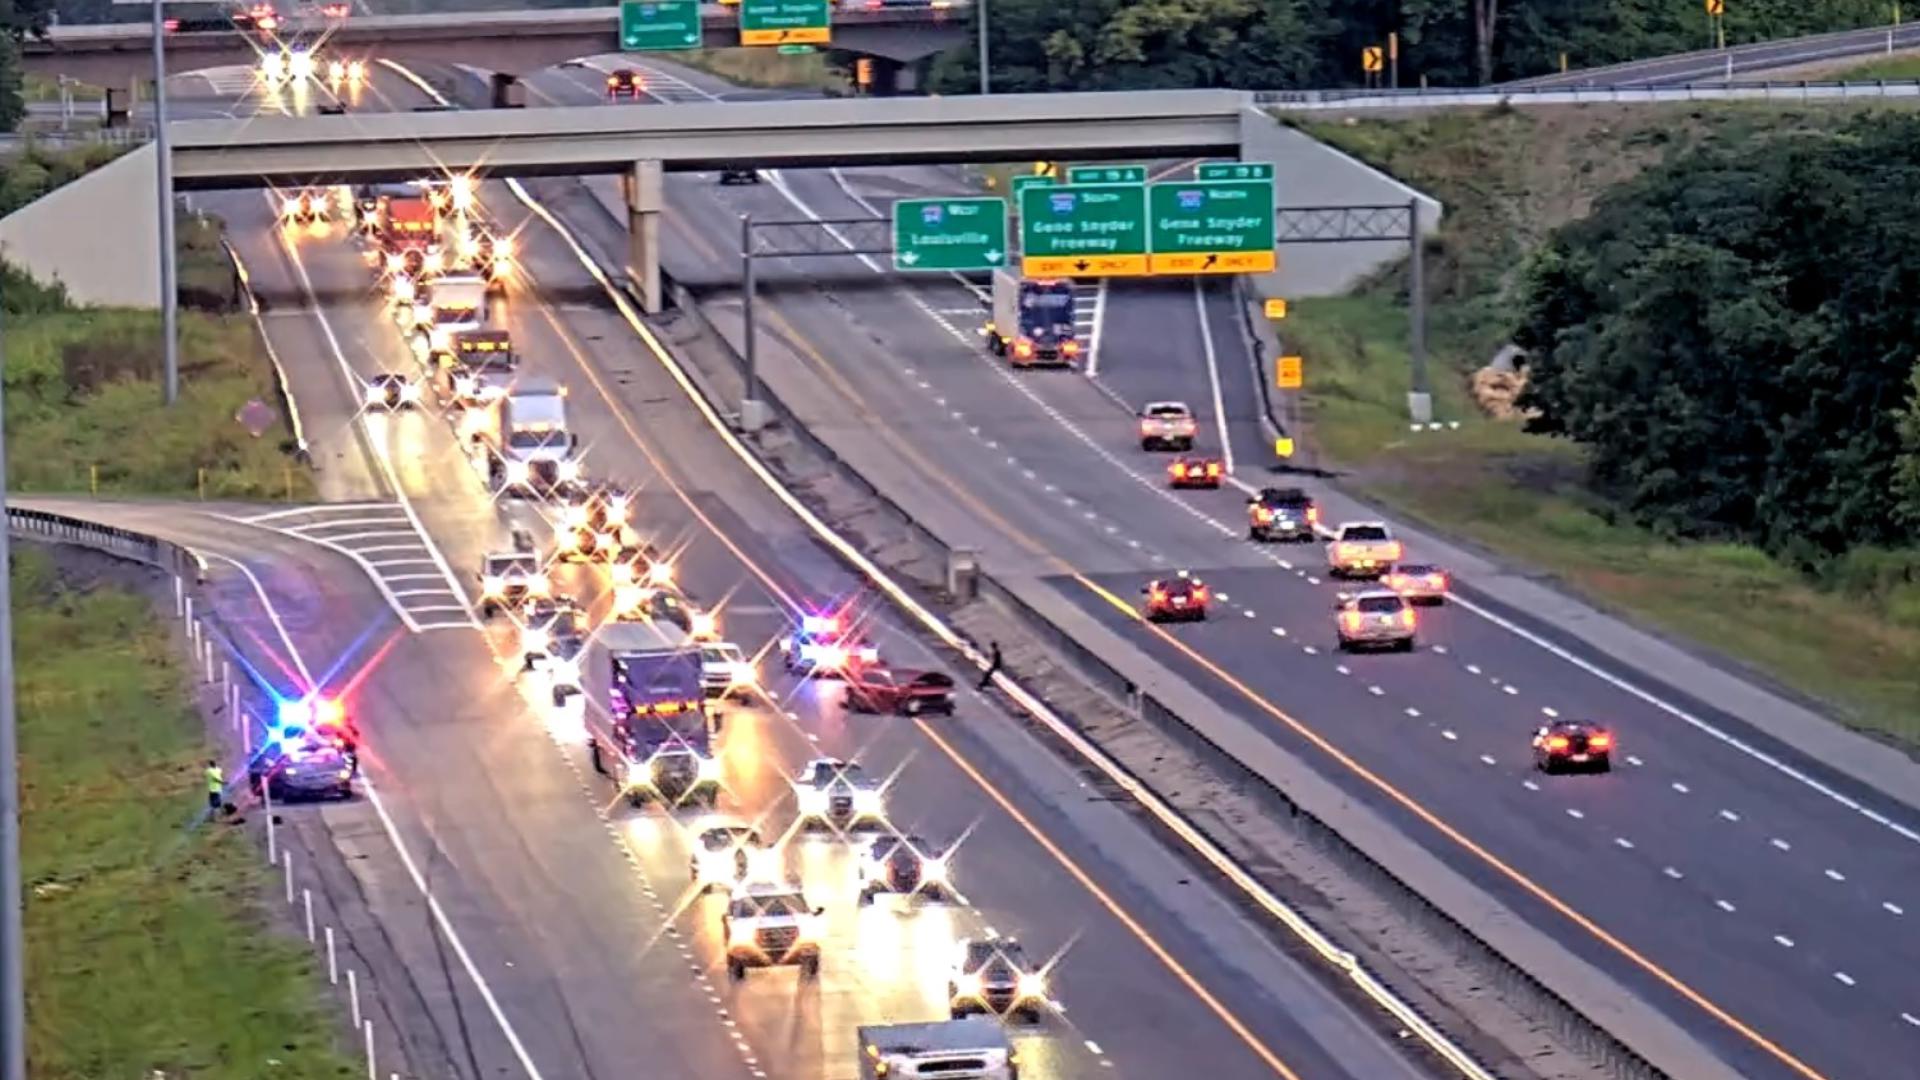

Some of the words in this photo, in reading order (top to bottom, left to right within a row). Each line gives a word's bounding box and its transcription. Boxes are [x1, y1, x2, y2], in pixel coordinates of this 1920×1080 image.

[1033, 221, 1074, 234] Gene
[1080, 220, 1135, 235] Snyder
[1206, 216, 1262, 231] Snyder
[1051, 237, 1118, 251] Freeway
[1178, 233, 1244, 248] Freeway
